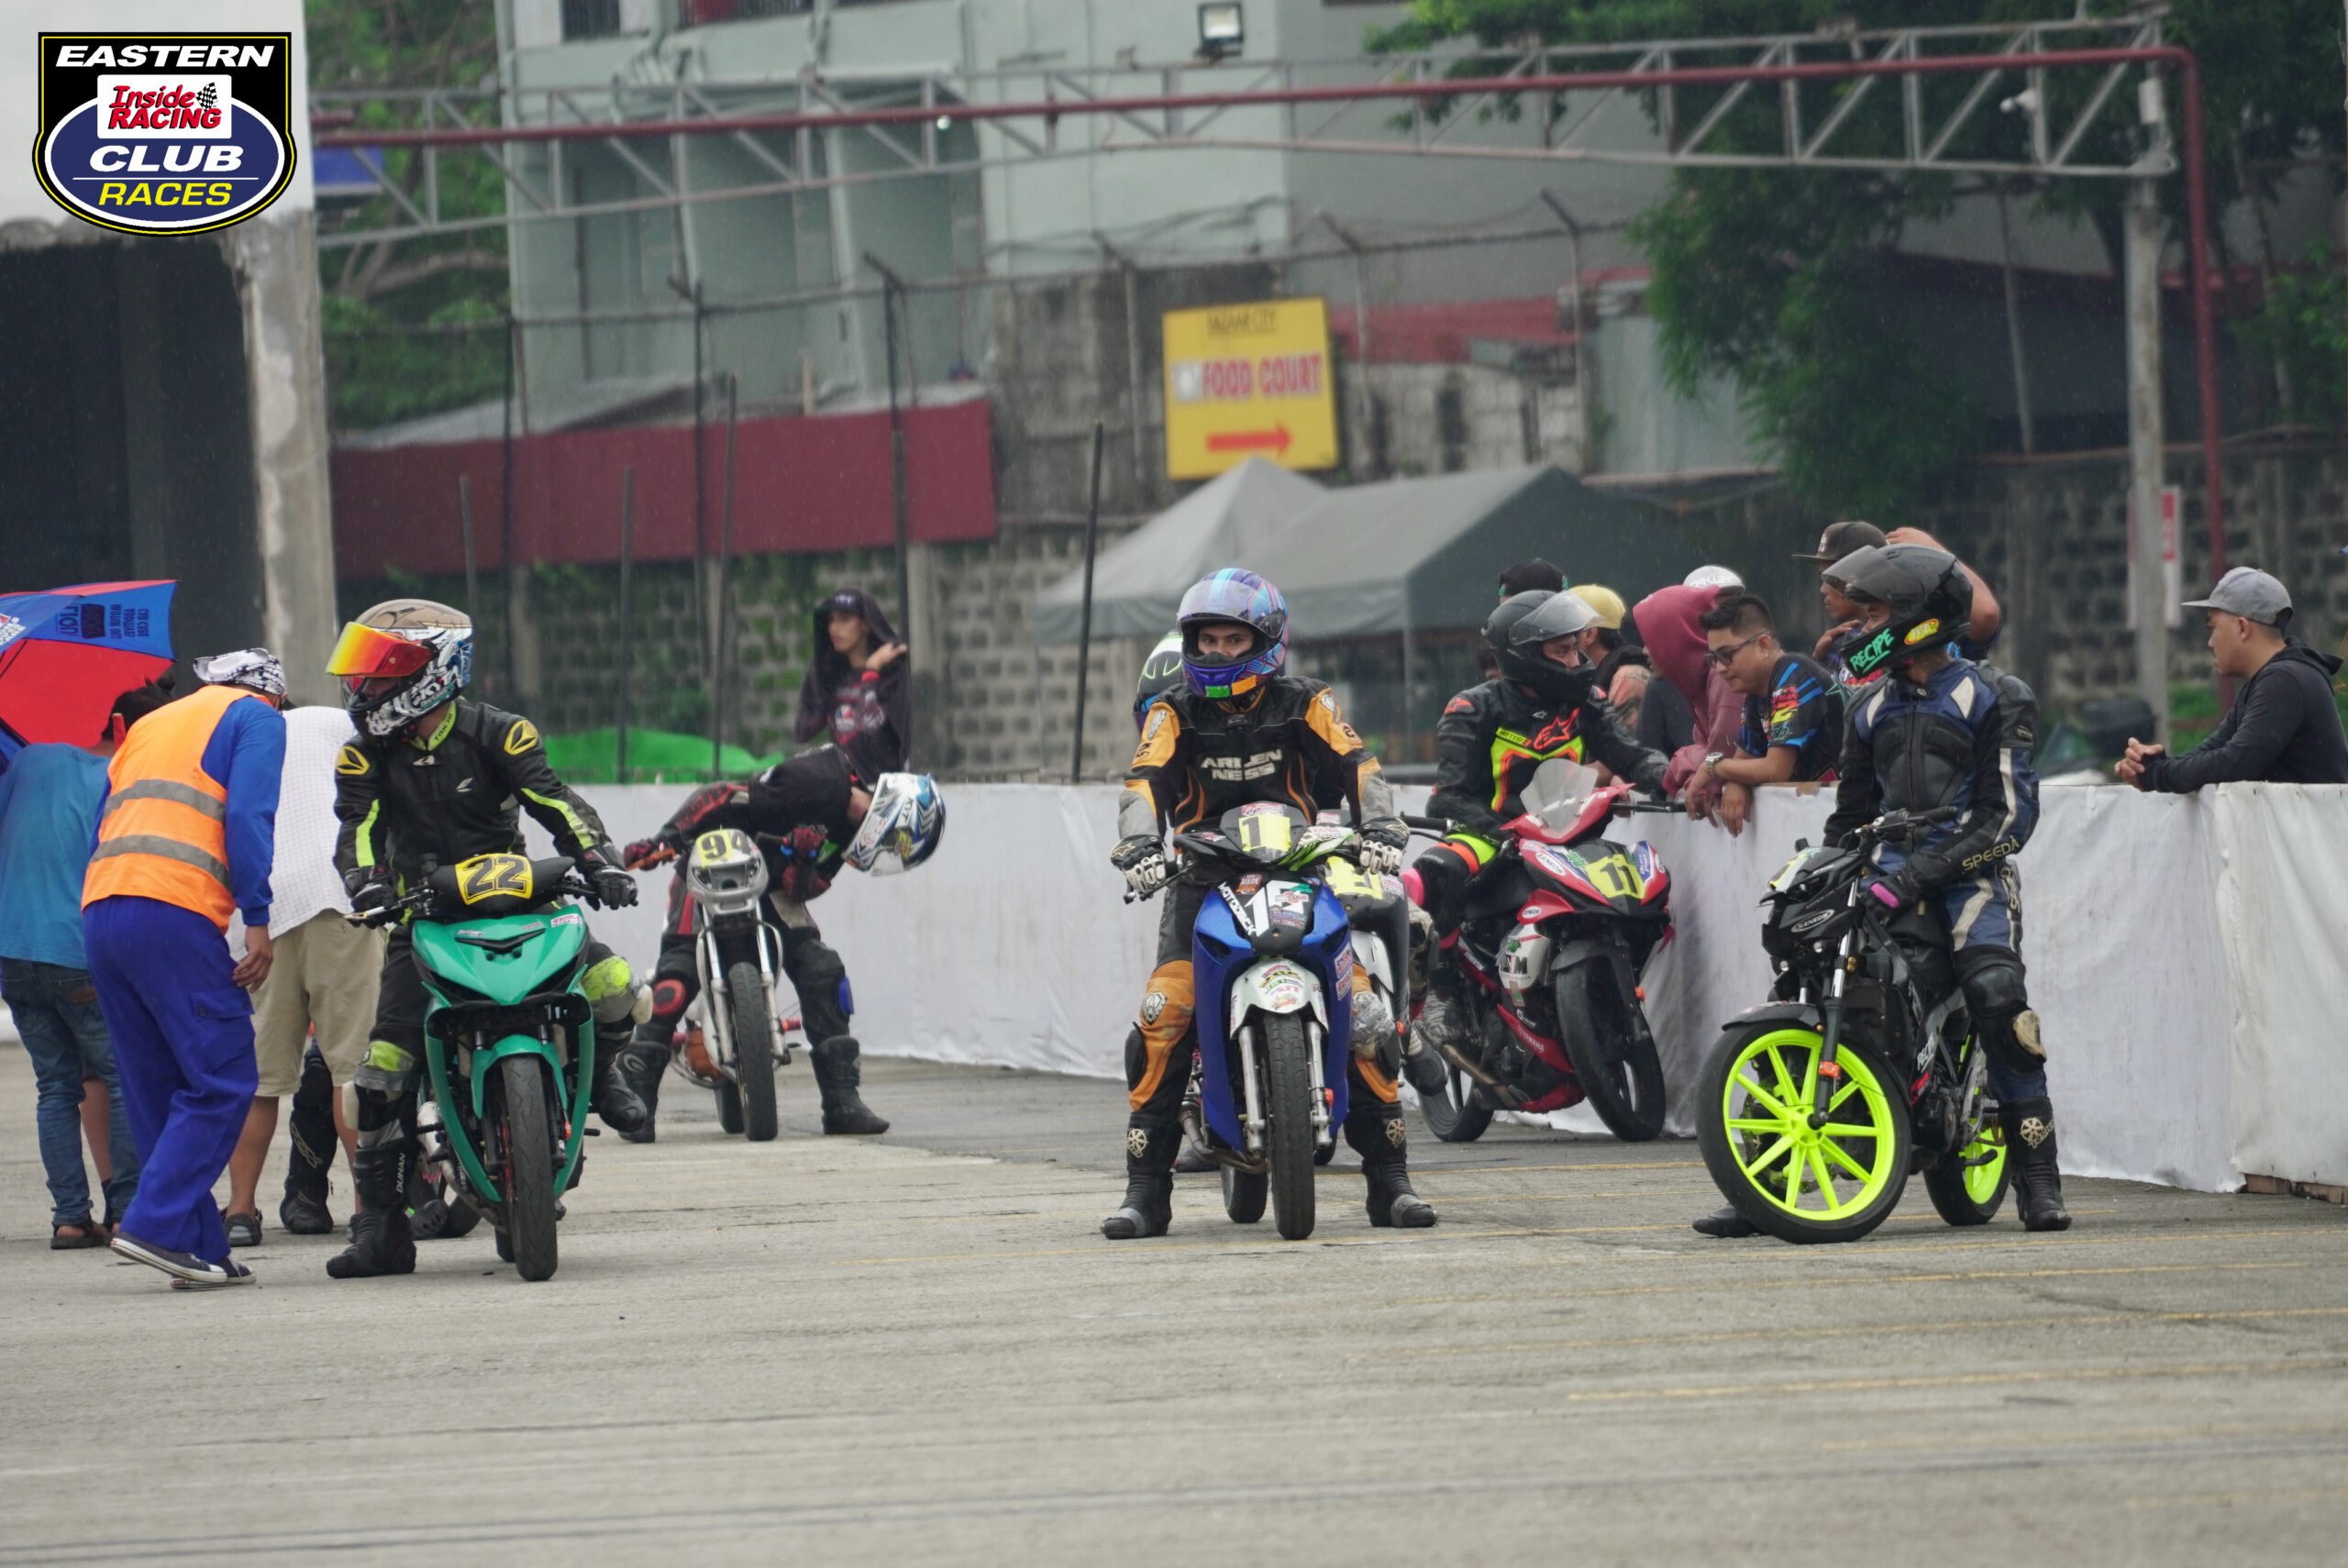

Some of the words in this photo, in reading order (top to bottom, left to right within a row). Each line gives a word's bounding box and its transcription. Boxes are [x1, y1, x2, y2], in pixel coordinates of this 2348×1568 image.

[1202, 359, 1253, 398] FOOD
[1258, 353, 1322, 396] COURT
[1849, 627, 1895, 671] RECIPE
[1211, 762, 1276, 781] NESS
[463, 856, 526, 900] 22
[1600, 861, 1638, 894] 11
[396, 1153, 405, 1193] DUHAN
